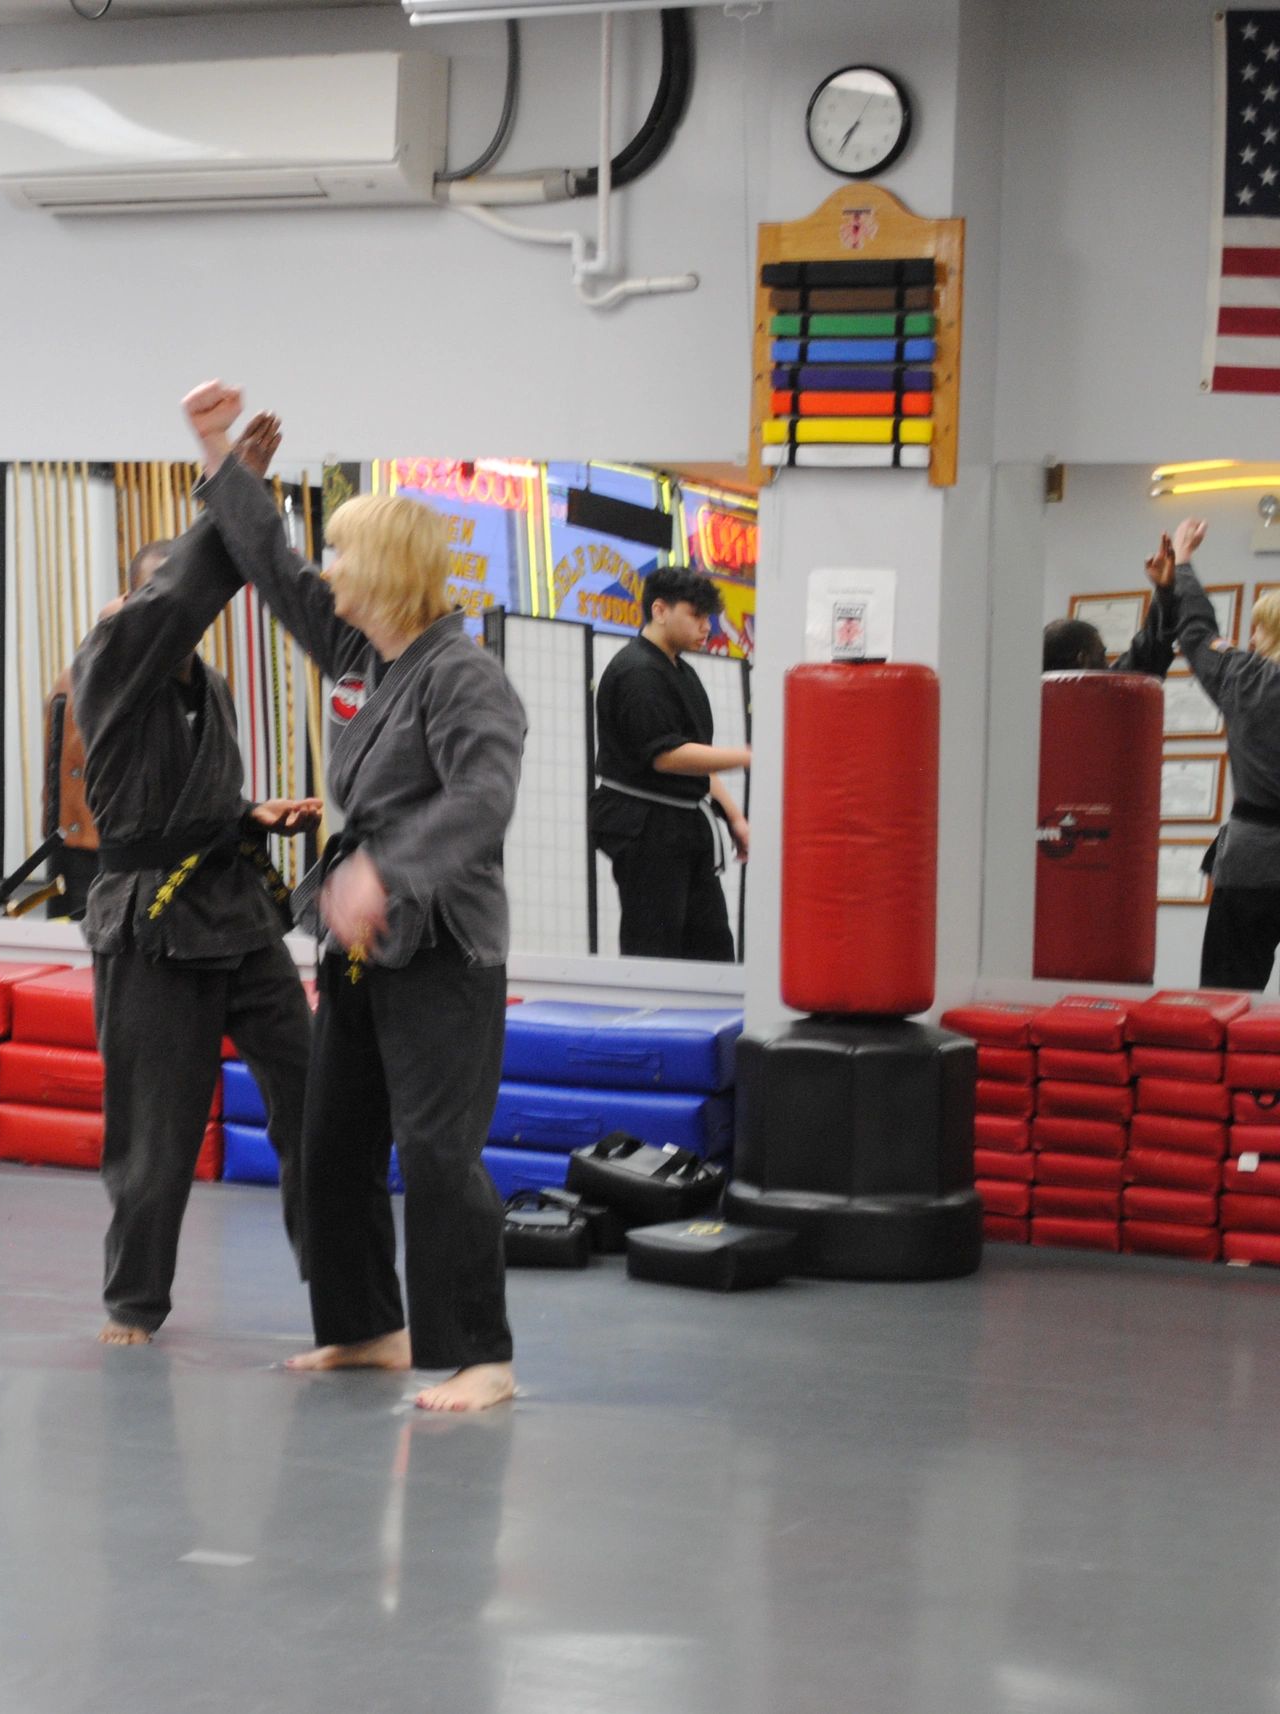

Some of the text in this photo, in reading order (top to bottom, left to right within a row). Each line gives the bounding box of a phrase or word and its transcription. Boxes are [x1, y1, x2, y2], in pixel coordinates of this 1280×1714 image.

[446, 514, 476, 547] EN
[447, 550, 488, 582] MEN
[577, 590, 644, 630] STUDIO
